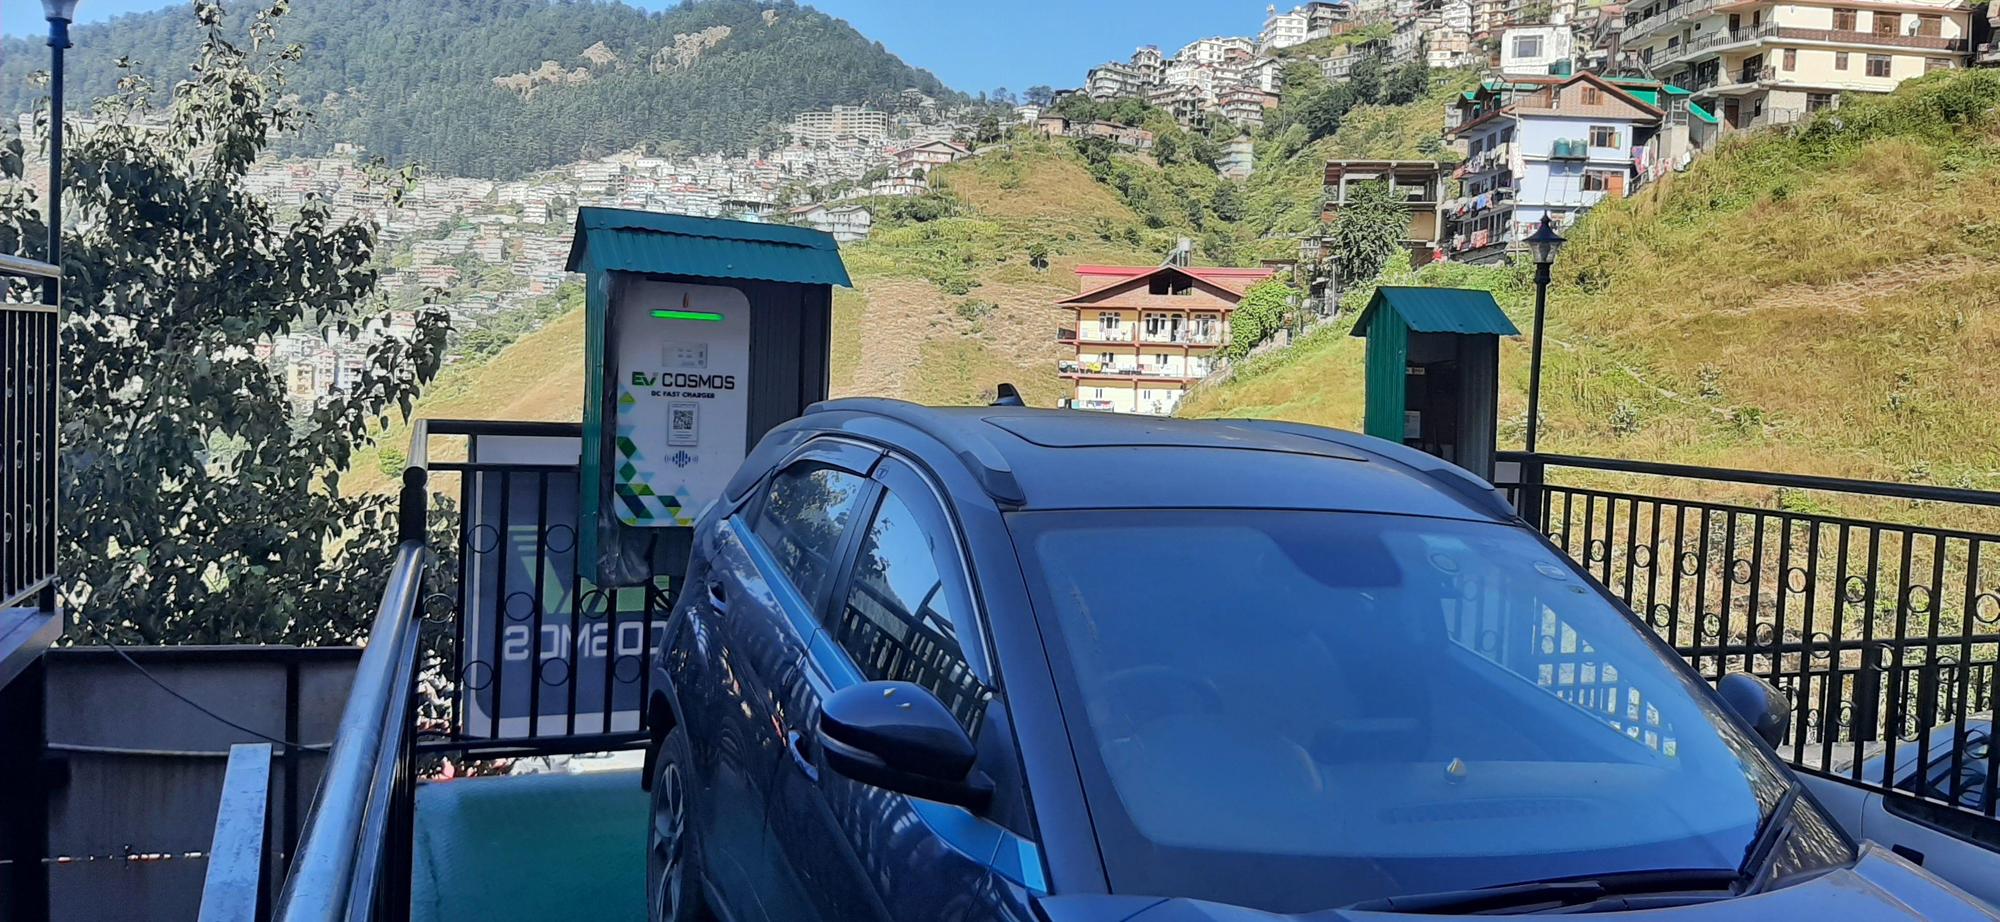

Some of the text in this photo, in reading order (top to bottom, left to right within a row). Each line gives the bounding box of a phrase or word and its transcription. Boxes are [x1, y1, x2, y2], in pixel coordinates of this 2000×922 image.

[632, 371, 735, 390] EV COSMOS
[682, 391, 716, 399] CHARGER
